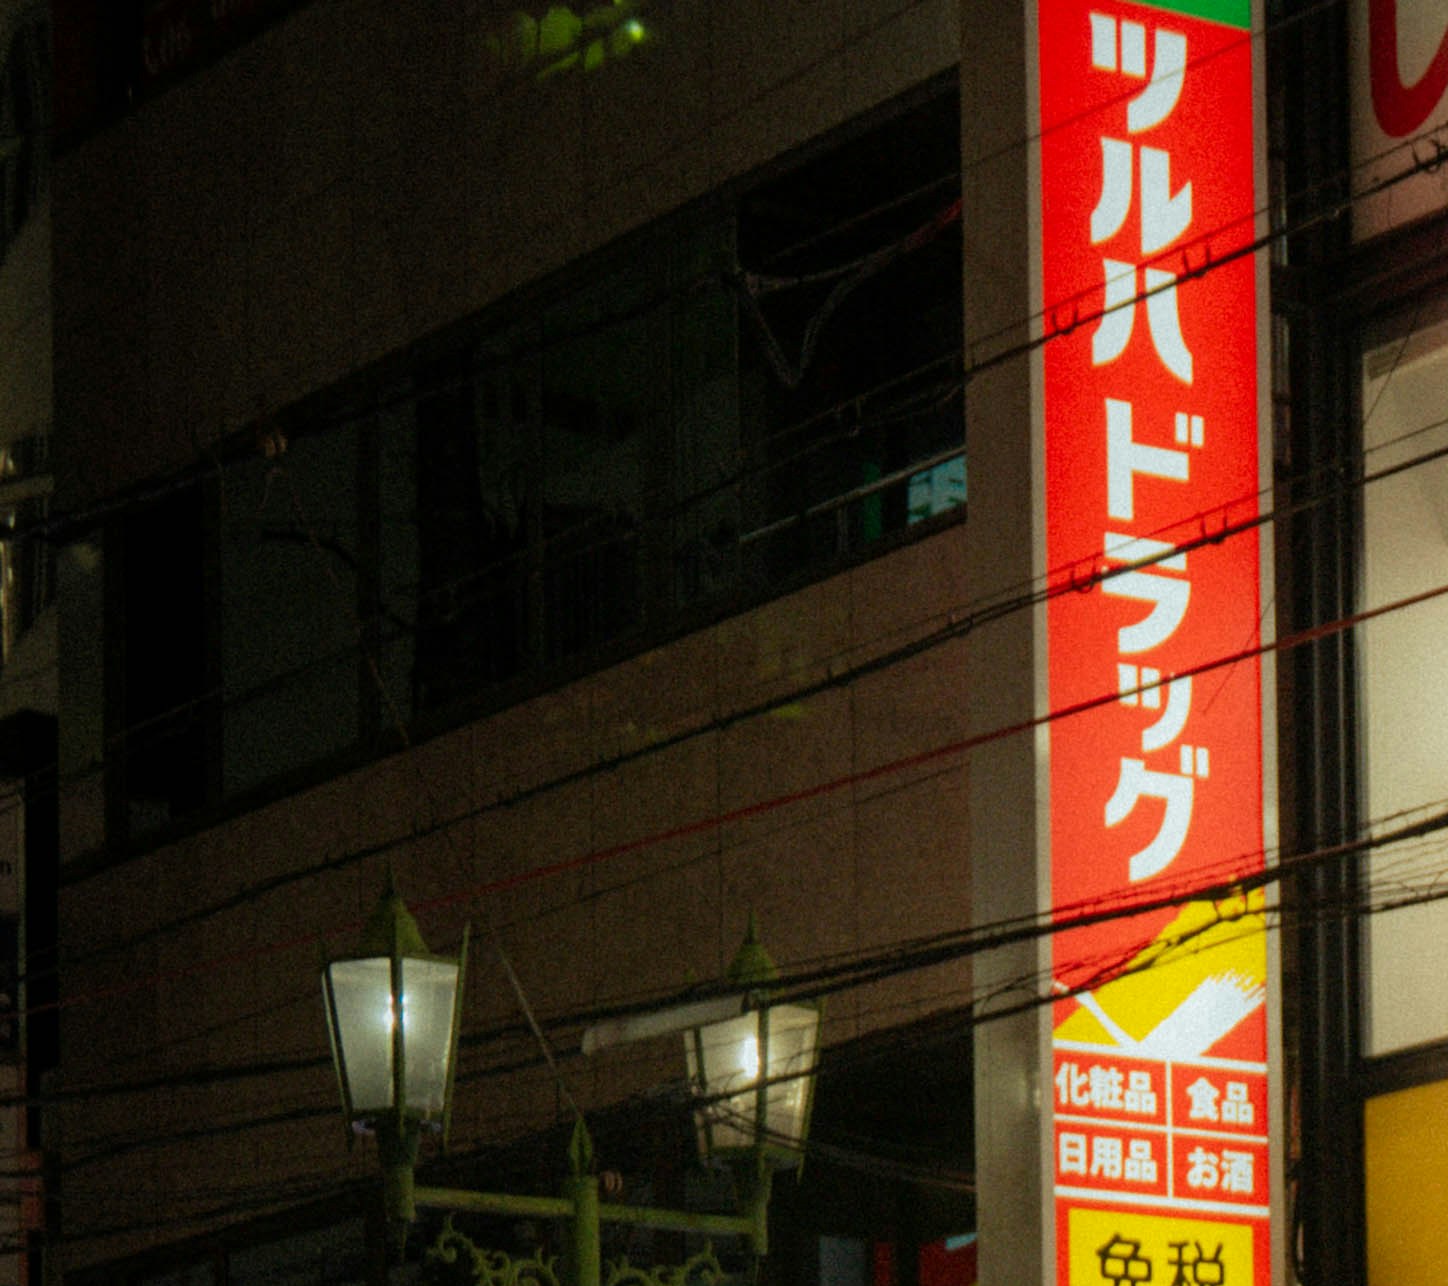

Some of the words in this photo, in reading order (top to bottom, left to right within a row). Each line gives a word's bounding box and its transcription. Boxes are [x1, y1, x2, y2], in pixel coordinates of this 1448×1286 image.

[1089, 12, 1210, 882] ツルハドラッグ
[1054, 1062, 1158, 1115] 化粧品
[1186, 1076, 1255, 1125] 食品
[1059, 1131, 1158, 1184] 日用品
[1187, 1145, 1255, 1195] お酒
